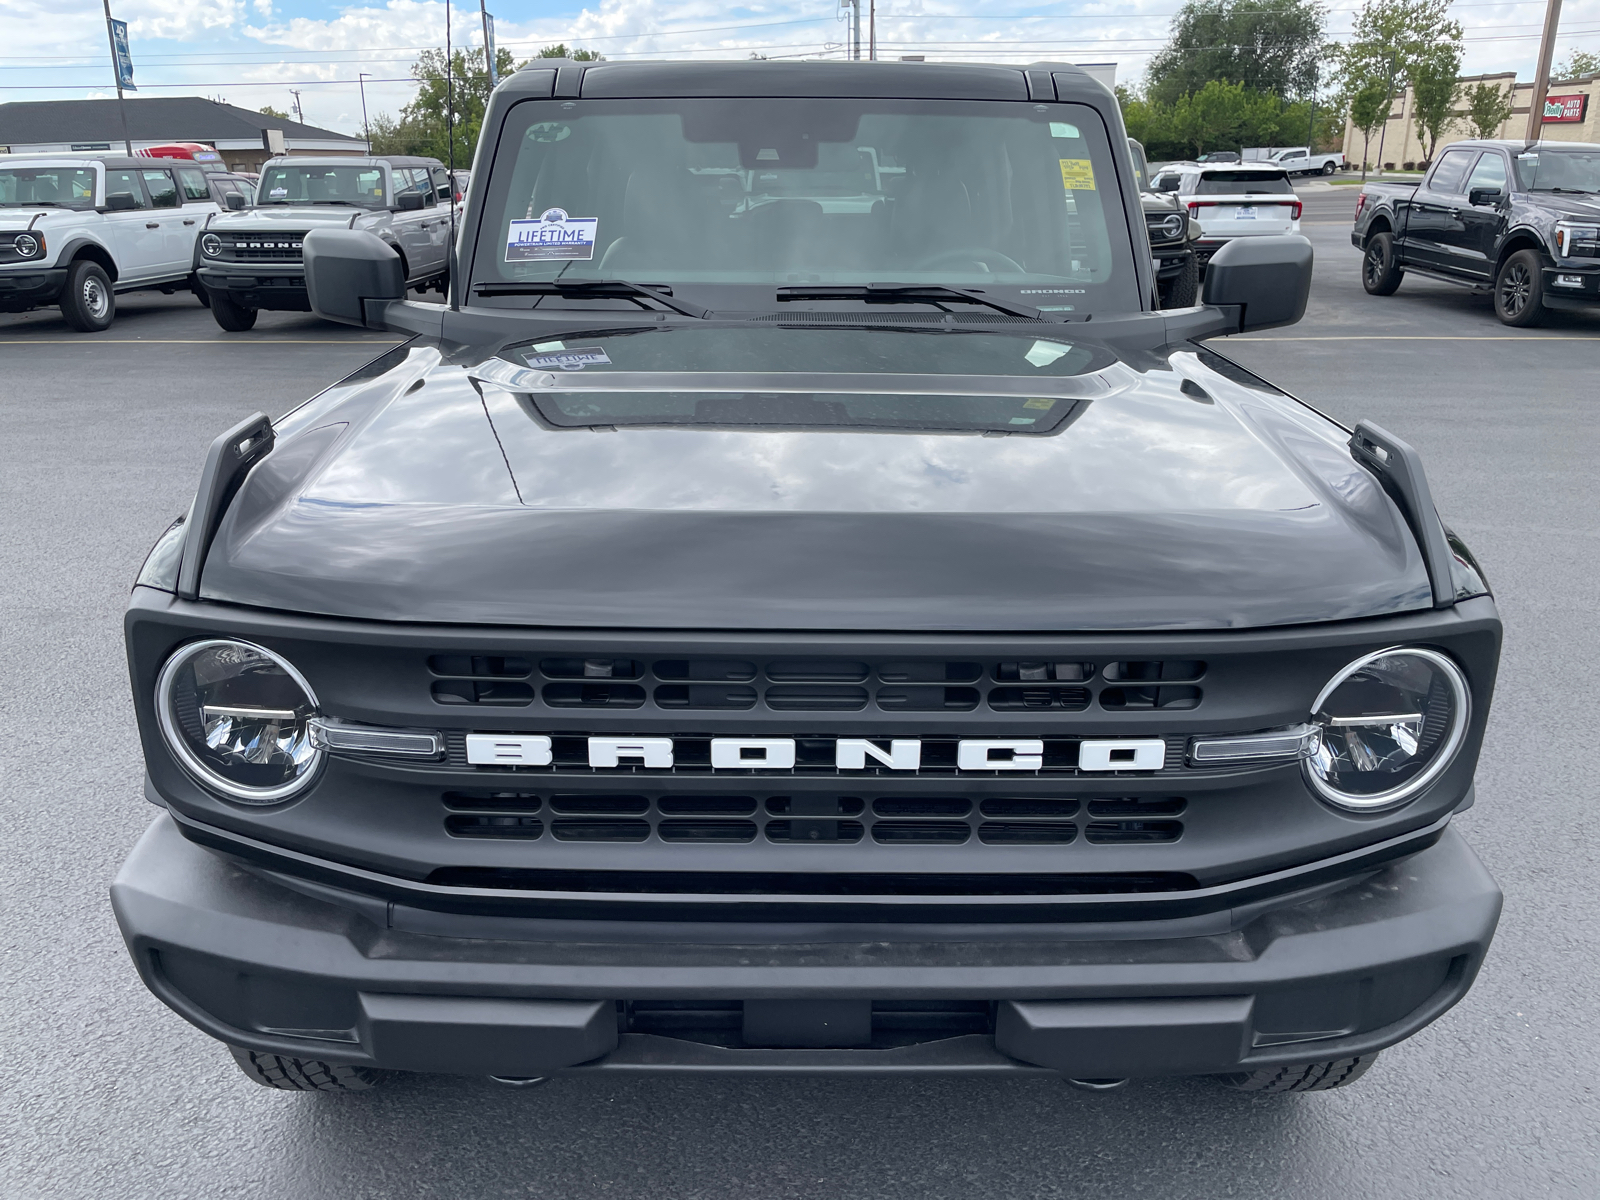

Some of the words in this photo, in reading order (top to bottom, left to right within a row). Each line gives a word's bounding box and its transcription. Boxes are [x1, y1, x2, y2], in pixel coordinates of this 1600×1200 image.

[1544, 101, 1564, 118] 'Reilly
[1566, 100, 1580, 108] AUTO
[1563, 109, 1580, 117] PARTS
[518, 229, 585, 242] LIFETIME
[466, 734, 1166, 771] BRONCO
